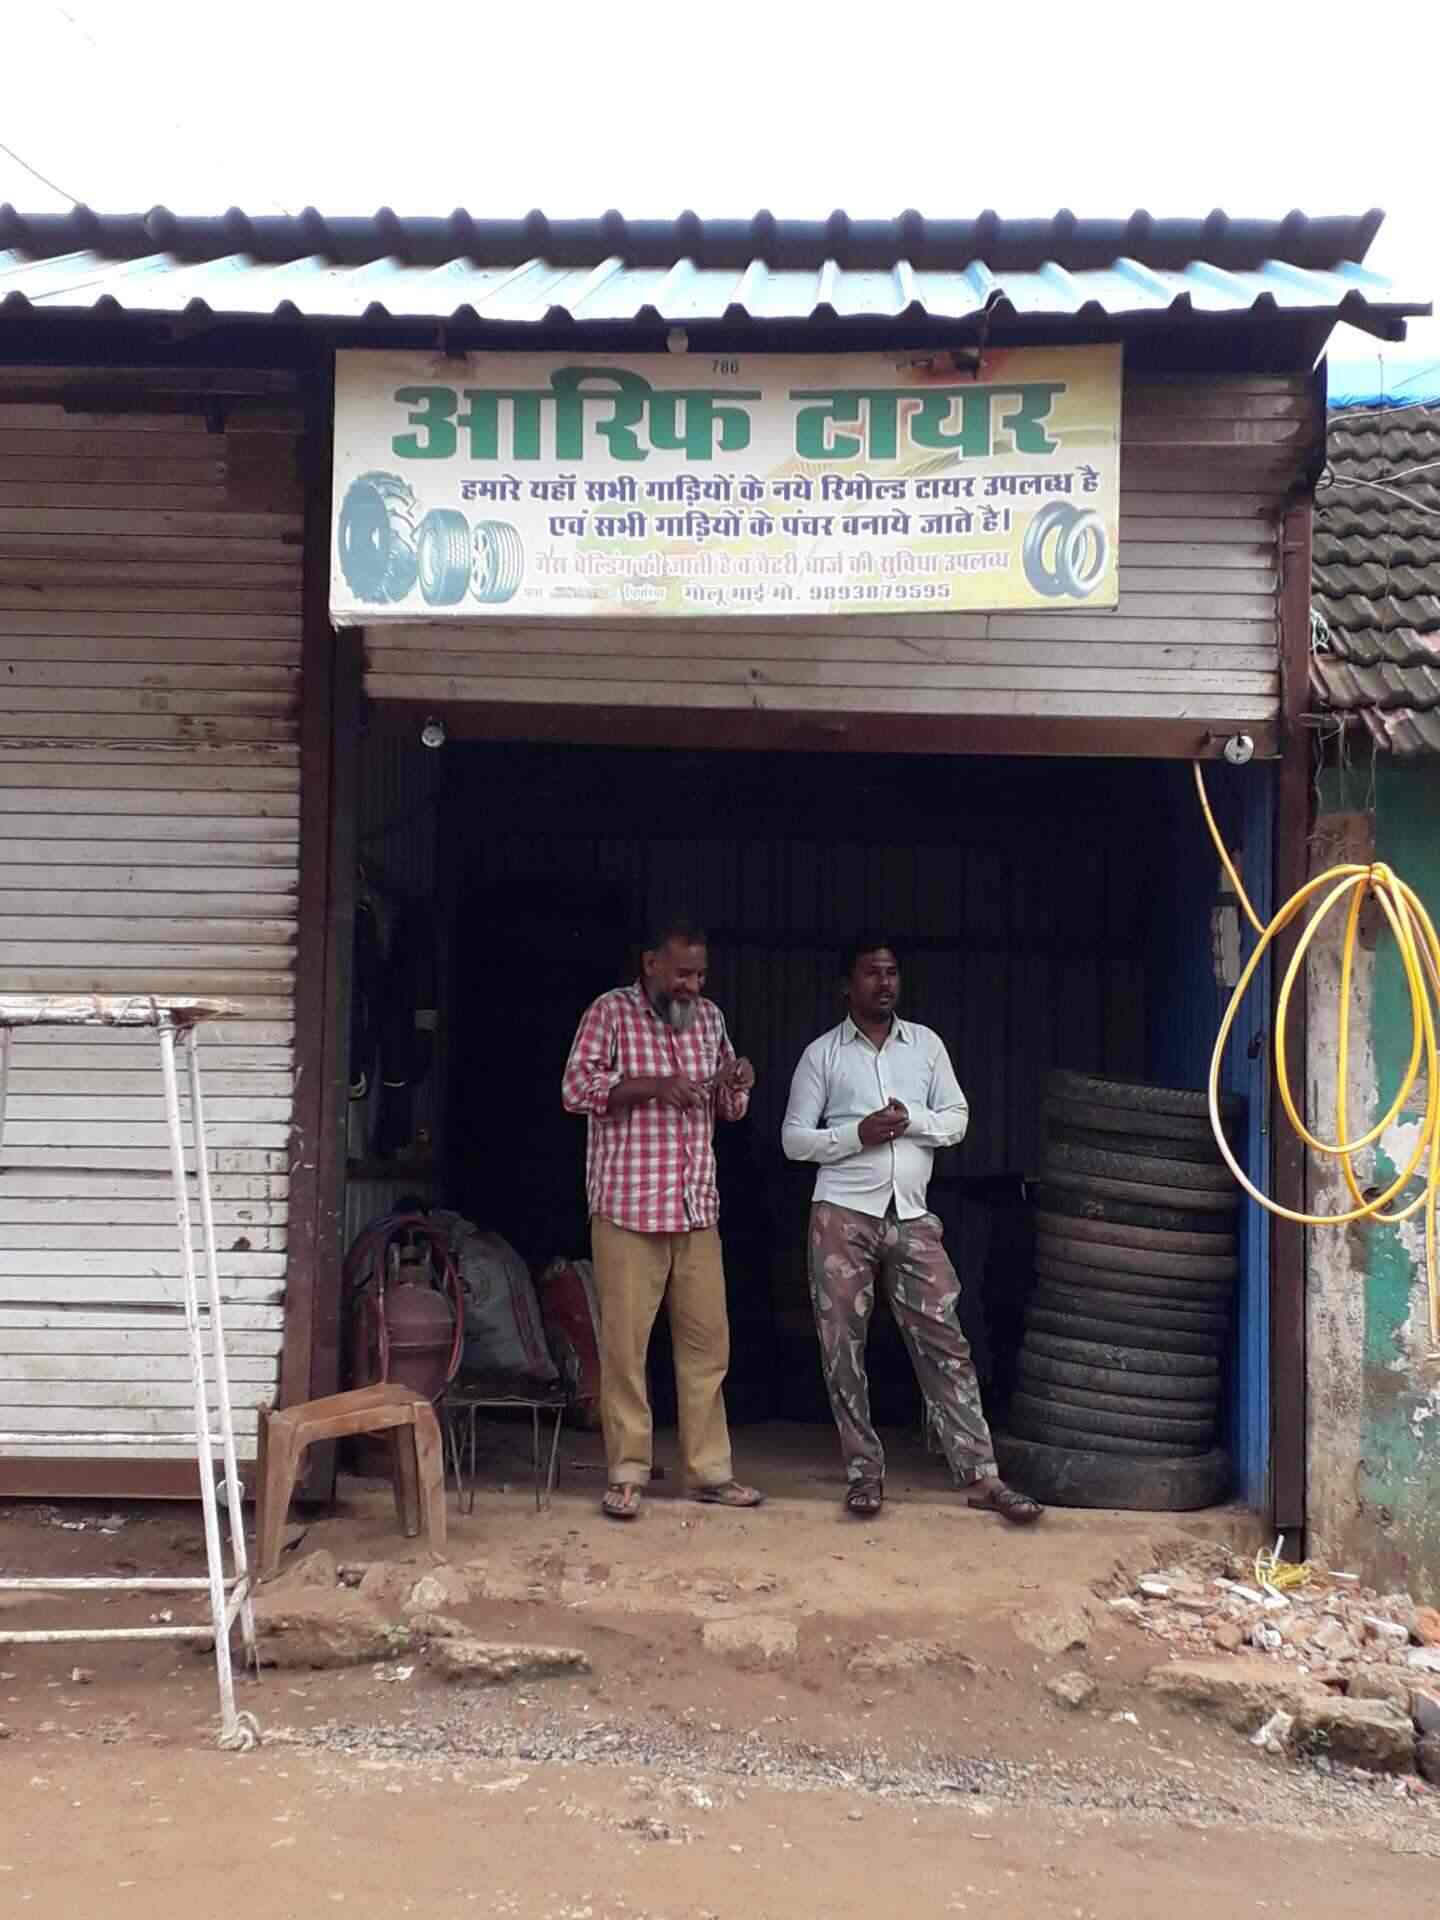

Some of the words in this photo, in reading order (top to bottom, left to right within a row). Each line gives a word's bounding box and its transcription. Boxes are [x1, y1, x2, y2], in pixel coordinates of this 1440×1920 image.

[392, 366, 761, 461] आरिफ
[790, 384, 1066, 460] टायर
[461, 474, 521, 501] हमारे
[585, 475, 636, 502] सभी
[646, 474, 734, 507] गाड़ियों
[740, 474, 764, 501] के
[772, 474, 813, 501] नये
[821, 473, 907, 501] रिमोल्ड
[915, 477, 976, 500] टायर
[1076, 465, 1101, 493] है
[548, 509, 588, 537] एवं
[595, 511, 646, 537] सभी
[655, 510, 745, 542] गाड़ियों
[750, 510, 774, 536] के
[782, 509, 833, 537] पंचर
[919, 506, 974, 534] जाते
